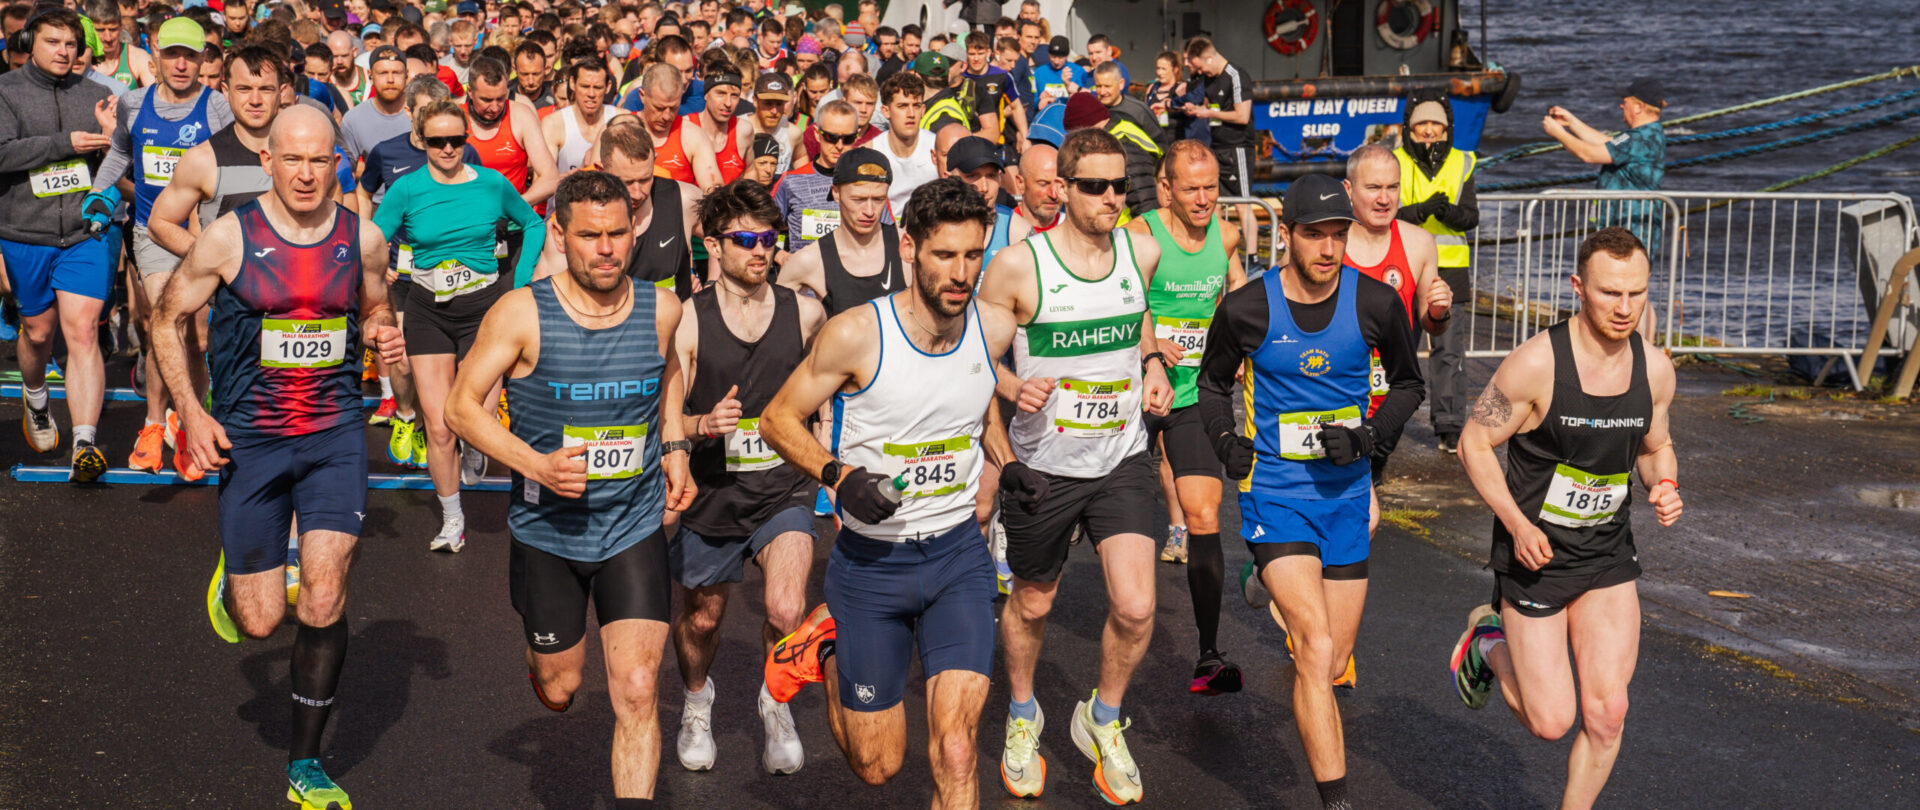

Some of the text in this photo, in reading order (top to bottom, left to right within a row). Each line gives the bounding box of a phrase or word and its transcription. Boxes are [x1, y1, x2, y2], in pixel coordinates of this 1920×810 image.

[1268, 98, 1398, 118] CLEW BAY QUEEN
[1302, 123, 1341, 137] SLIGO
[43, 173, 80, 190] 1256
[810, 186, 829, 195] BMW
[445, 269, 471, 287] 979
[1164, 280, 1212, 292] Macmillan
[1052, 322, 1138, 349] RAHENY
[279, 340, 332, 358] 1029
[547, 377, 659, 401] TEMPO
[1073, 401, 1119, 420] 1784
[1560, 416, 1644, 428] TOP4RUNNING
[742, 437, 773, 454] 11
[920, 454, 954, 462] MARATHON
[1565, 490, 1612, 511] 1815
